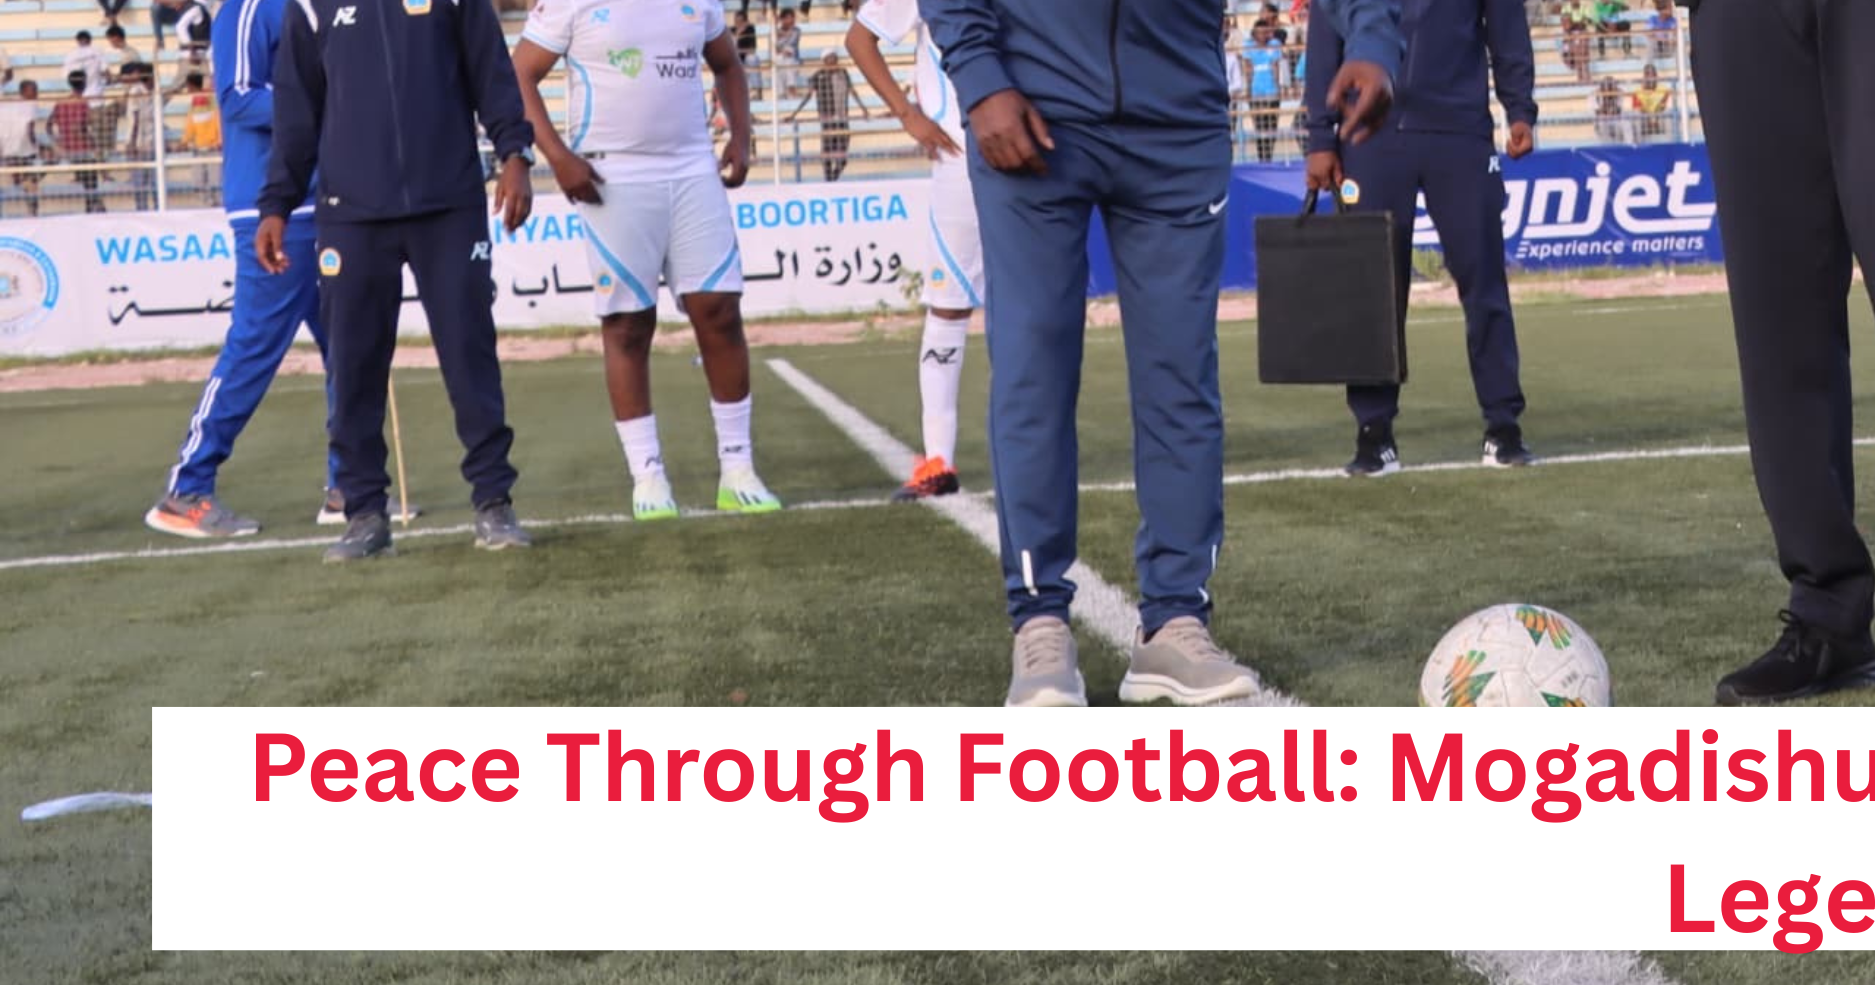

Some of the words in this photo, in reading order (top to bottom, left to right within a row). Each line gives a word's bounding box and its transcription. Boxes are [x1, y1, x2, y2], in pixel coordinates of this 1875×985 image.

[814, 242, 903, 286] وزارة
[1515, 240, 1625, 261] Experience
[1631, 235, 1705, 253] matters
